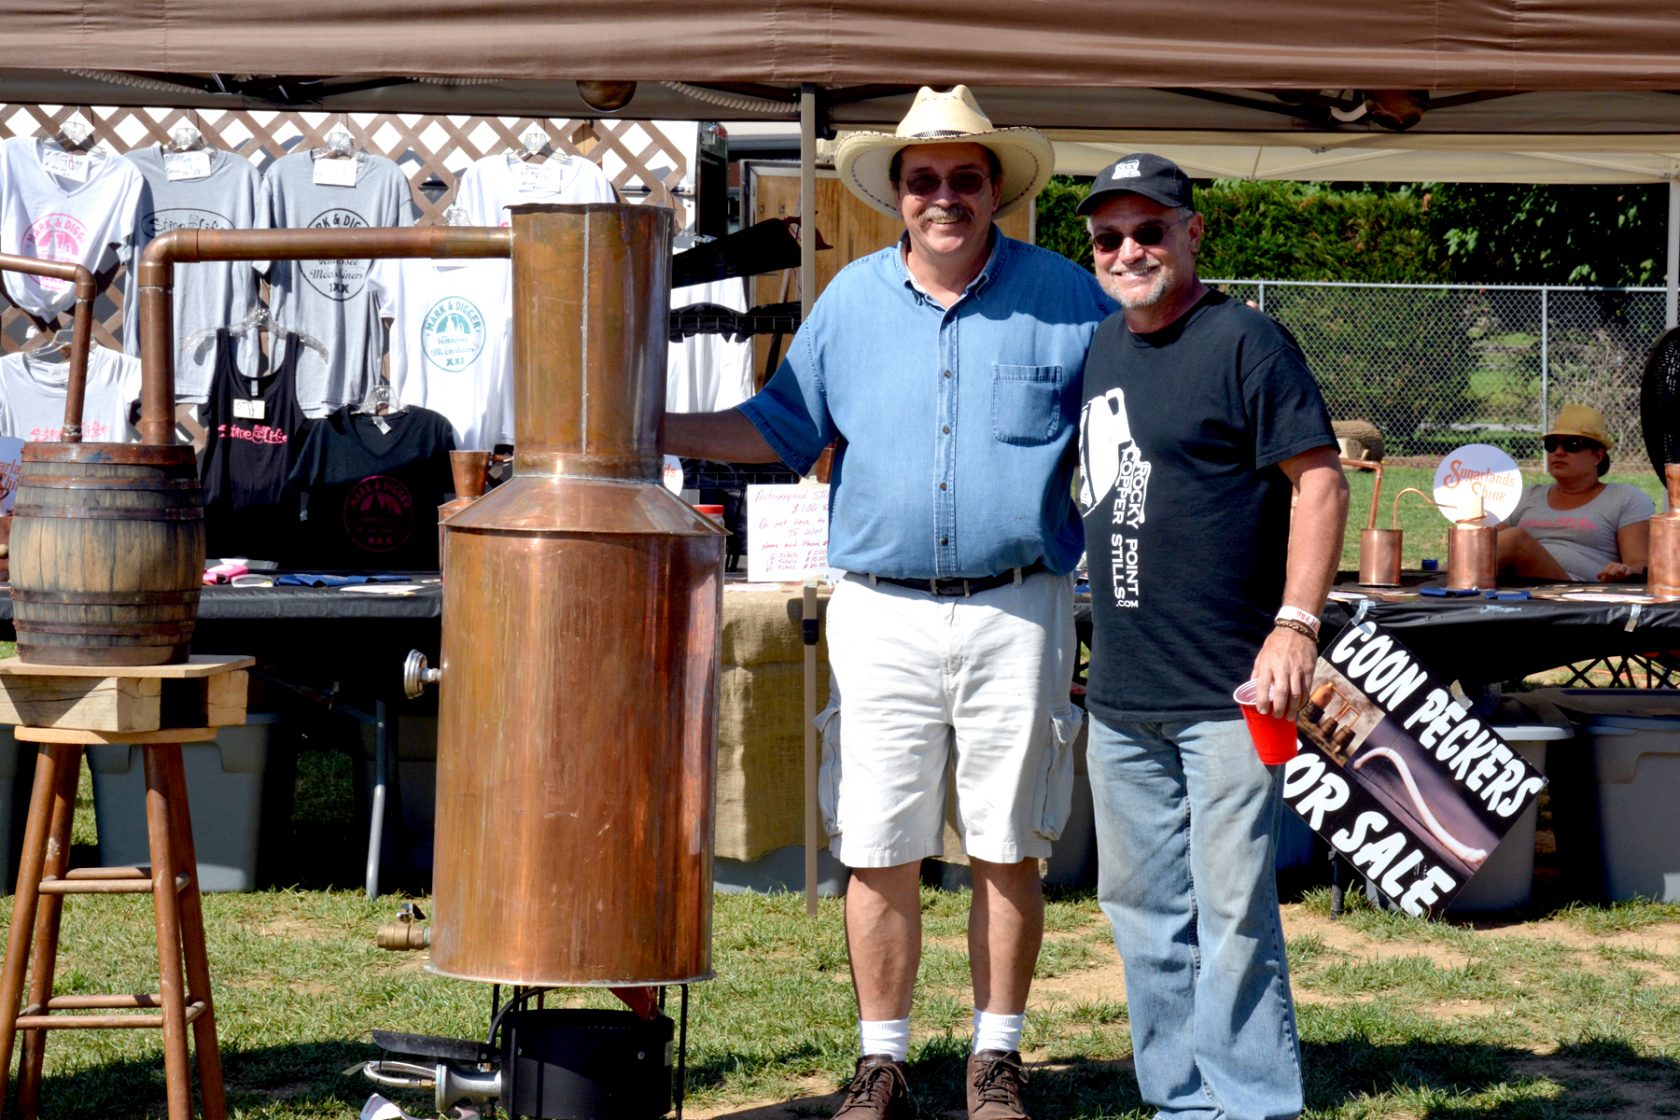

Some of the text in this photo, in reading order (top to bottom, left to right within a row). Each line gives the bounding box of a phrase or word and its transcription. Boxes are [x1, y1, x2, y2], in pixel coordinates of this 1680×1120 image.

[54, 218, 62, 228] &
[333, 213, 341, 225] &
[425, 301, 482, 331] MARK & DIGGER
[1443, 459, 1516, 489] Sugarlands
[1471, 481, 1506, 502] Shine
[1111, 450, 1135, 599] COPPER STILLS
[1125, 462, 1147, 596] ROCKY POINT
[1331, 620, 1545, 818] COON PECKERS
[1283, 742, 1457, 918] OR SALE
